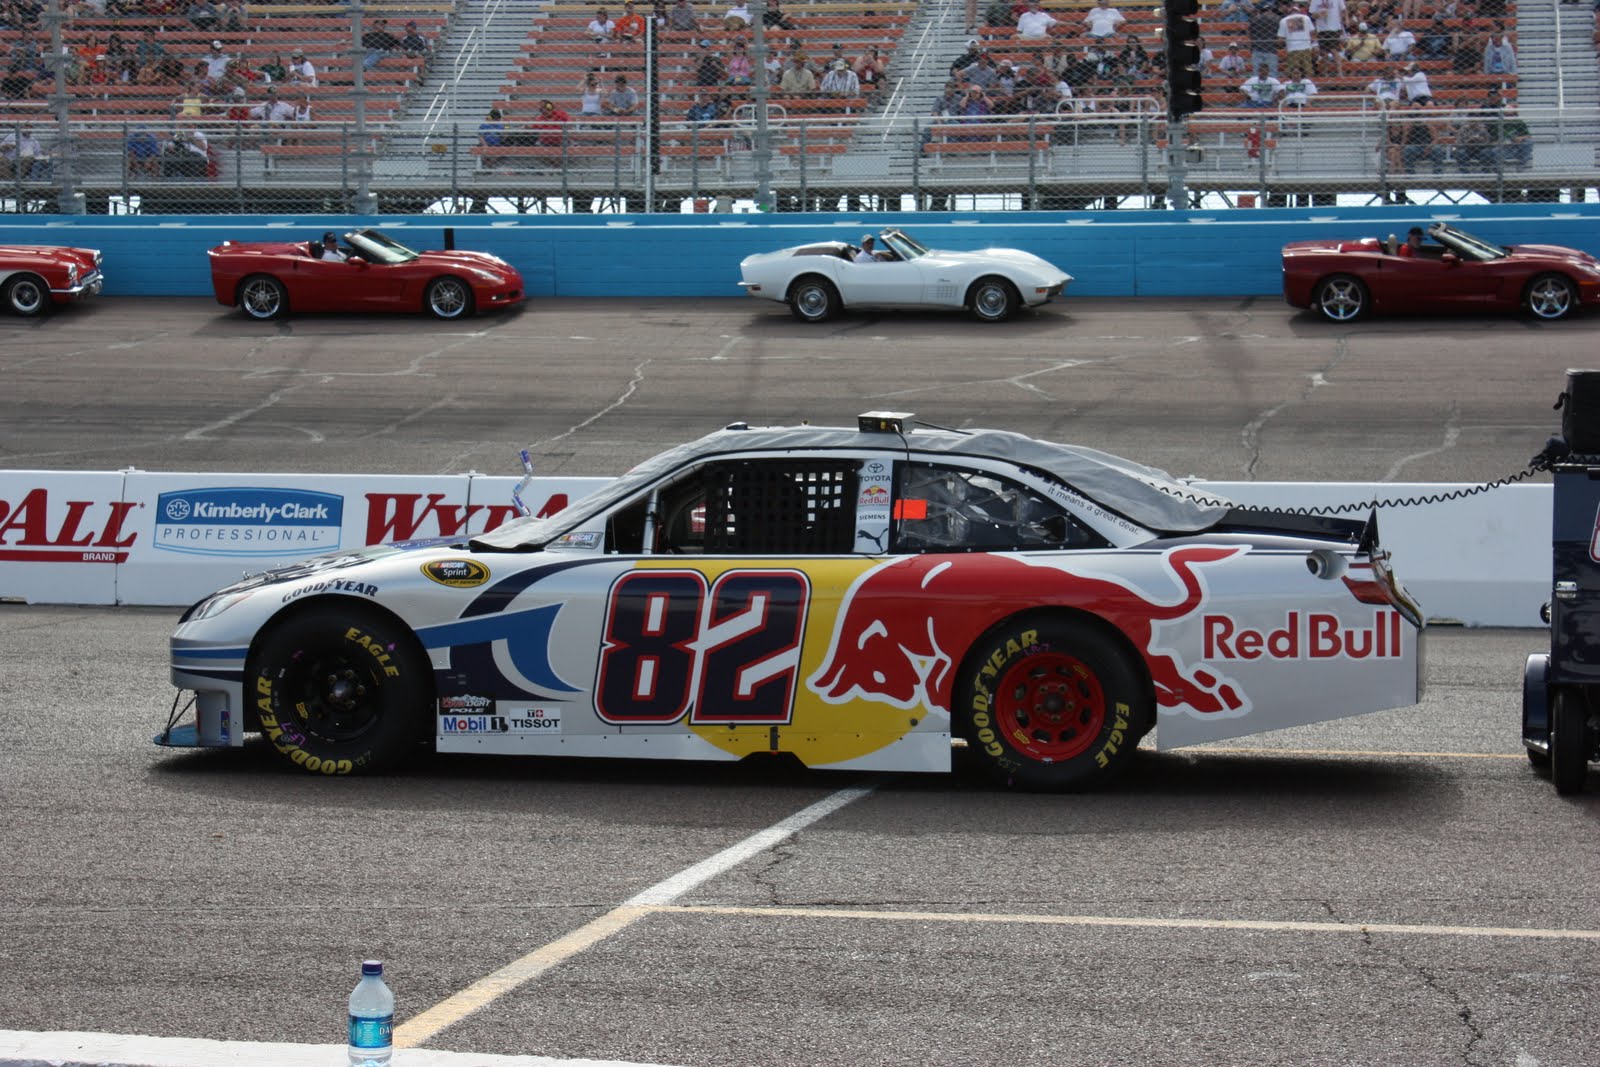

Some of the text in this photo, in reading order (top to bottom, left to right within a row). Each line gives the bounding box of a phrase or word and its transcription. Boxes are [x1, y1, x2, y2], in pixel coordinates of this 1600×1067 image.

[193, 502, 328, 523] Kimberly-Clark
[859, 496, 889, 505] Red Bull
[1047, 486, 1056, 494] It
[1056, 490, 1086, 508] means
[1093, 508, 1119, 525] great
[1119, 520, 1140, 535] deal.
[163, 528, 320, 541] PROFESSIONAL
[83, 552, 115, 561] BRAND
[443, 568, 467, 577] Sprint
[282, 578, 378, 602] GOODYEAR
[592, 568, 812, 726] 82
[1204, 611, 1401, 659] Red Bull
[345, 627, 400, 677] EAGLE
[973, 629, 1039, 756] GOODYEAR
[257, 676, 352, 774] GOODYEAR
[443, 717, 486, 730] Mobil
[511, 719, 560, 728] TISSOT
[1095, 702, 1130, 768] EAGLE
